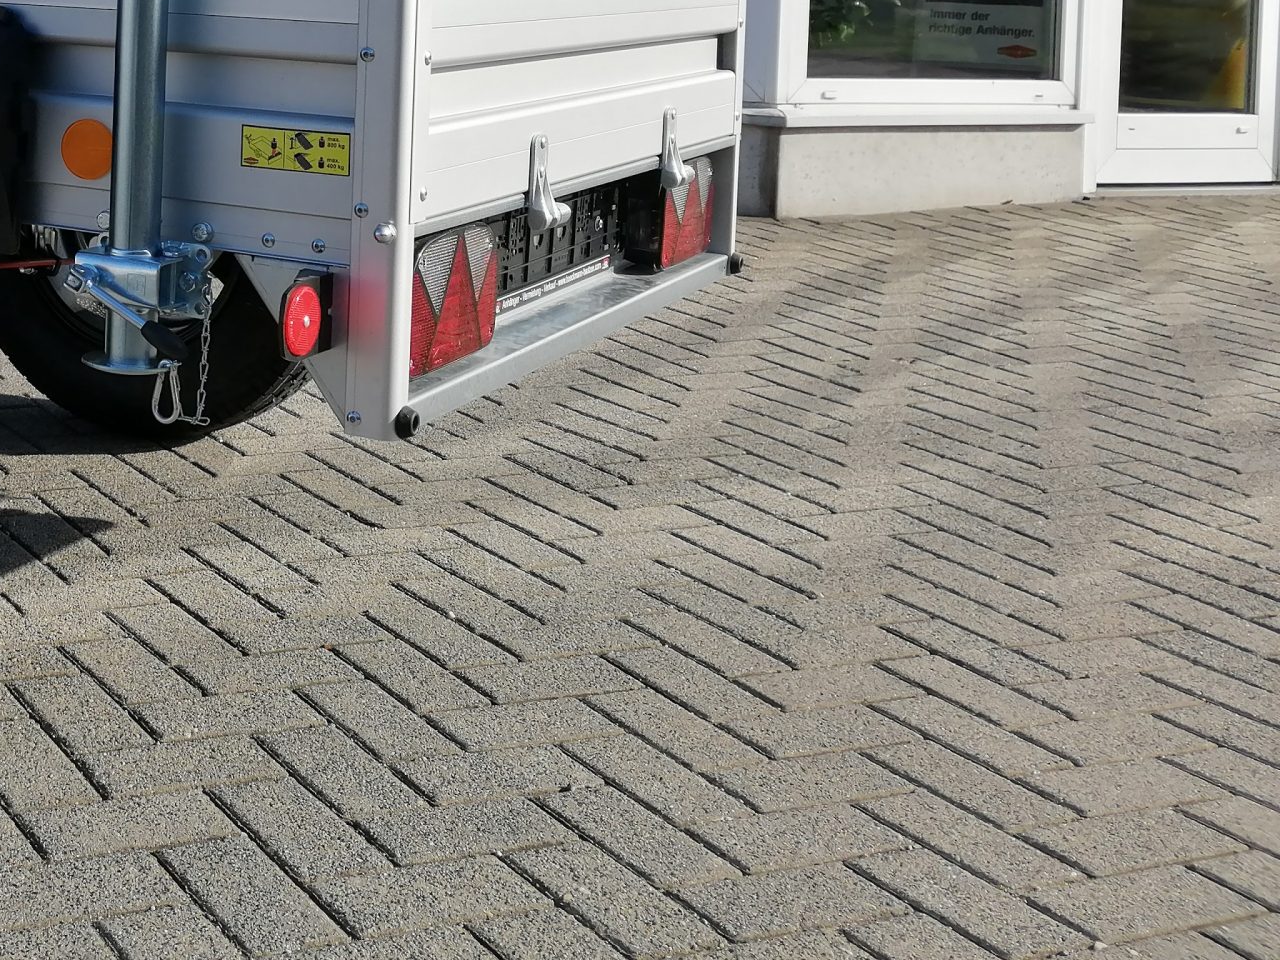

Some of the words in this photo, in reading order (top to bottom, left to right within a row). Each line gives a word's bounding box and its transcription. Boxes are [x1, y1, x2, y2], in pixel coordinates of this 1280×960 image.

[930, 9, 968, 21] Immer
[970, 10, 991, 21] der
[976, 24, 1035, 38] Anhänger.
